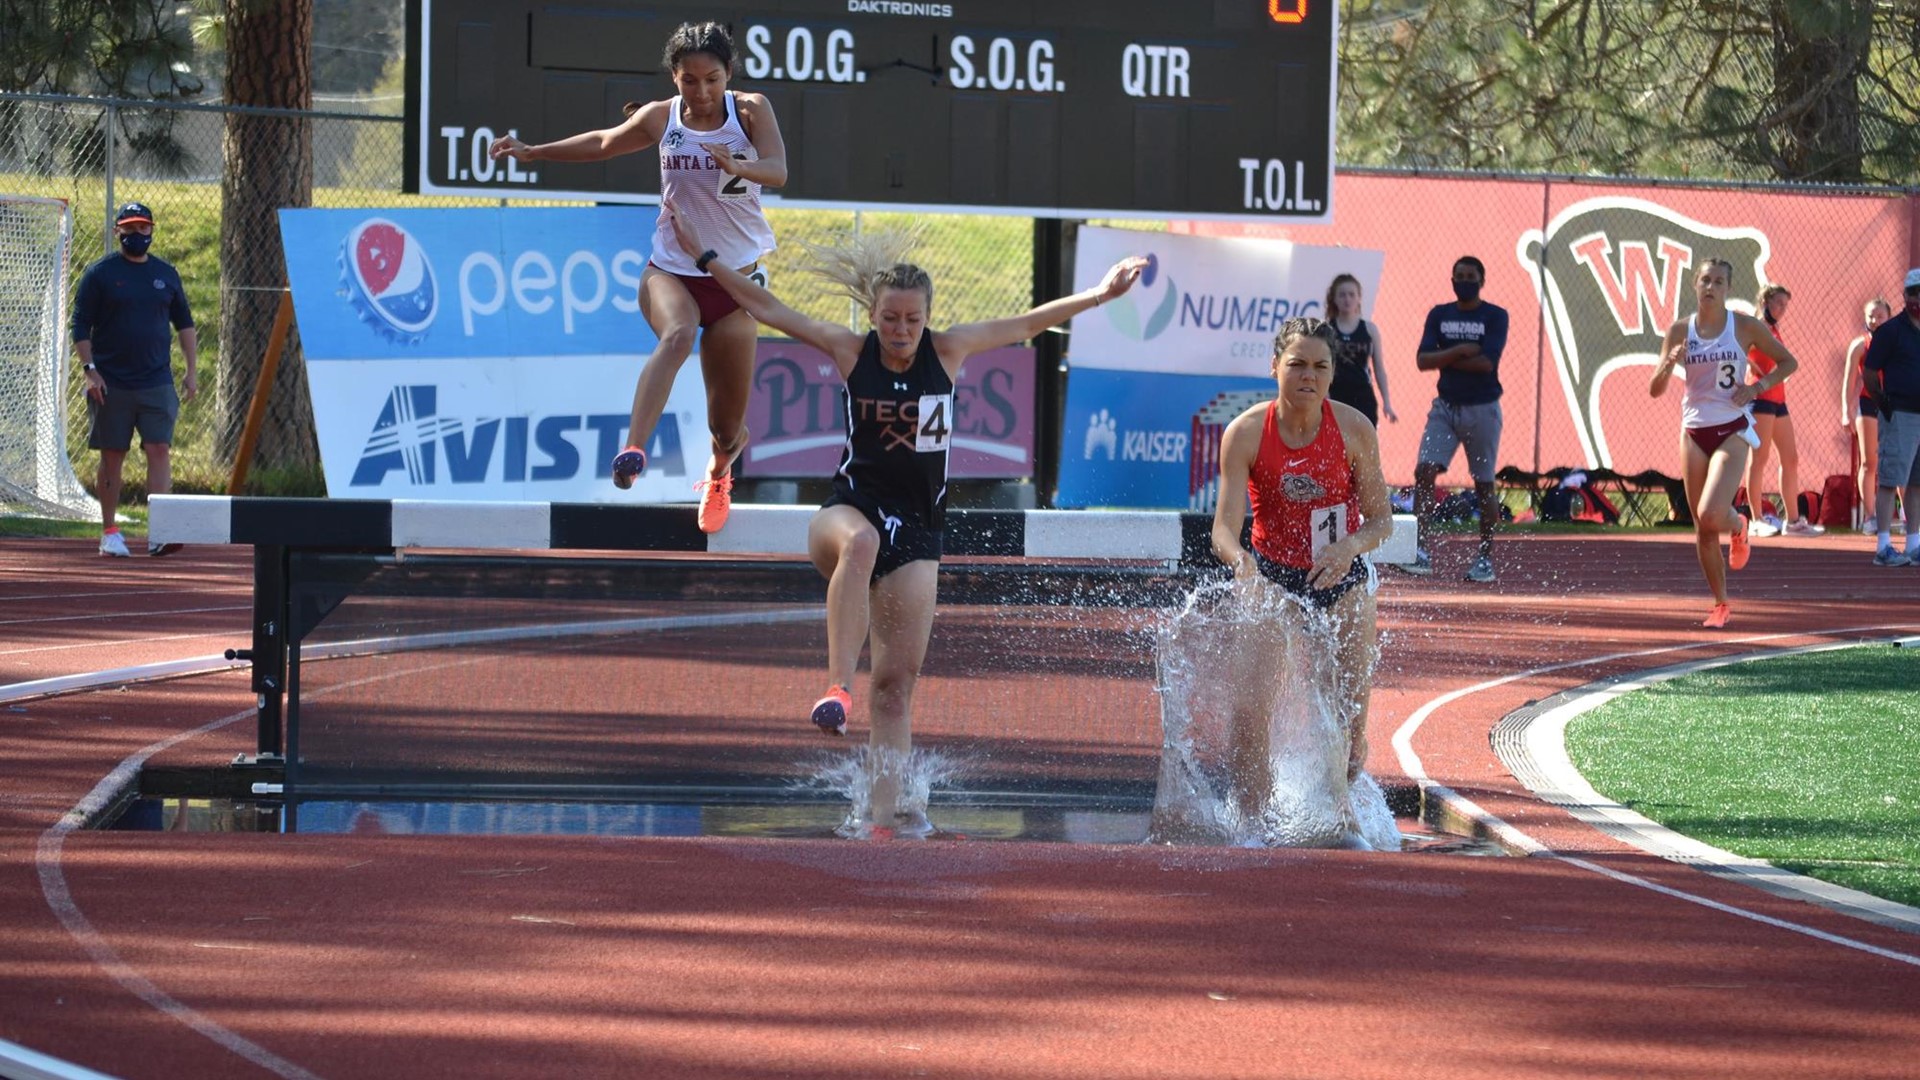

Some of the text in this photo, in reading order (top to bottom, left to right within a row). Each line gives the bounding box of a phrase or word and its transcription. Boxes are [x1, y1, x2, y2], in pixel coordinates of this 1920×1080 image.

[847, 0, 953, 17] DAKTRONICS
[745, 25, 867, 83] S.O.G.
[949, 36, 1066, 93] S.O.G.
[1121, 44, 1191, 98] QTR
[441, 126, 538, 183] T.O.L.
[1239, 158, 1321, 211] T.O.L.
[458, 250, 644, 337] peps
[1569, 230, 1693, 338] W
[1180, 292, 1320, 333] NUMERIC
[1440, 321, 1485, 336] GONZAGA
[1709, 351, 1738, 362] CLARA
[1719, 364, 1736, 390] 3
[857, 398, 919, 421] TEC
[920, 400, 948, 445] 4
[1122, 430, 1188, 463] KAISER
[1318, 511, 1337, 545] 1
